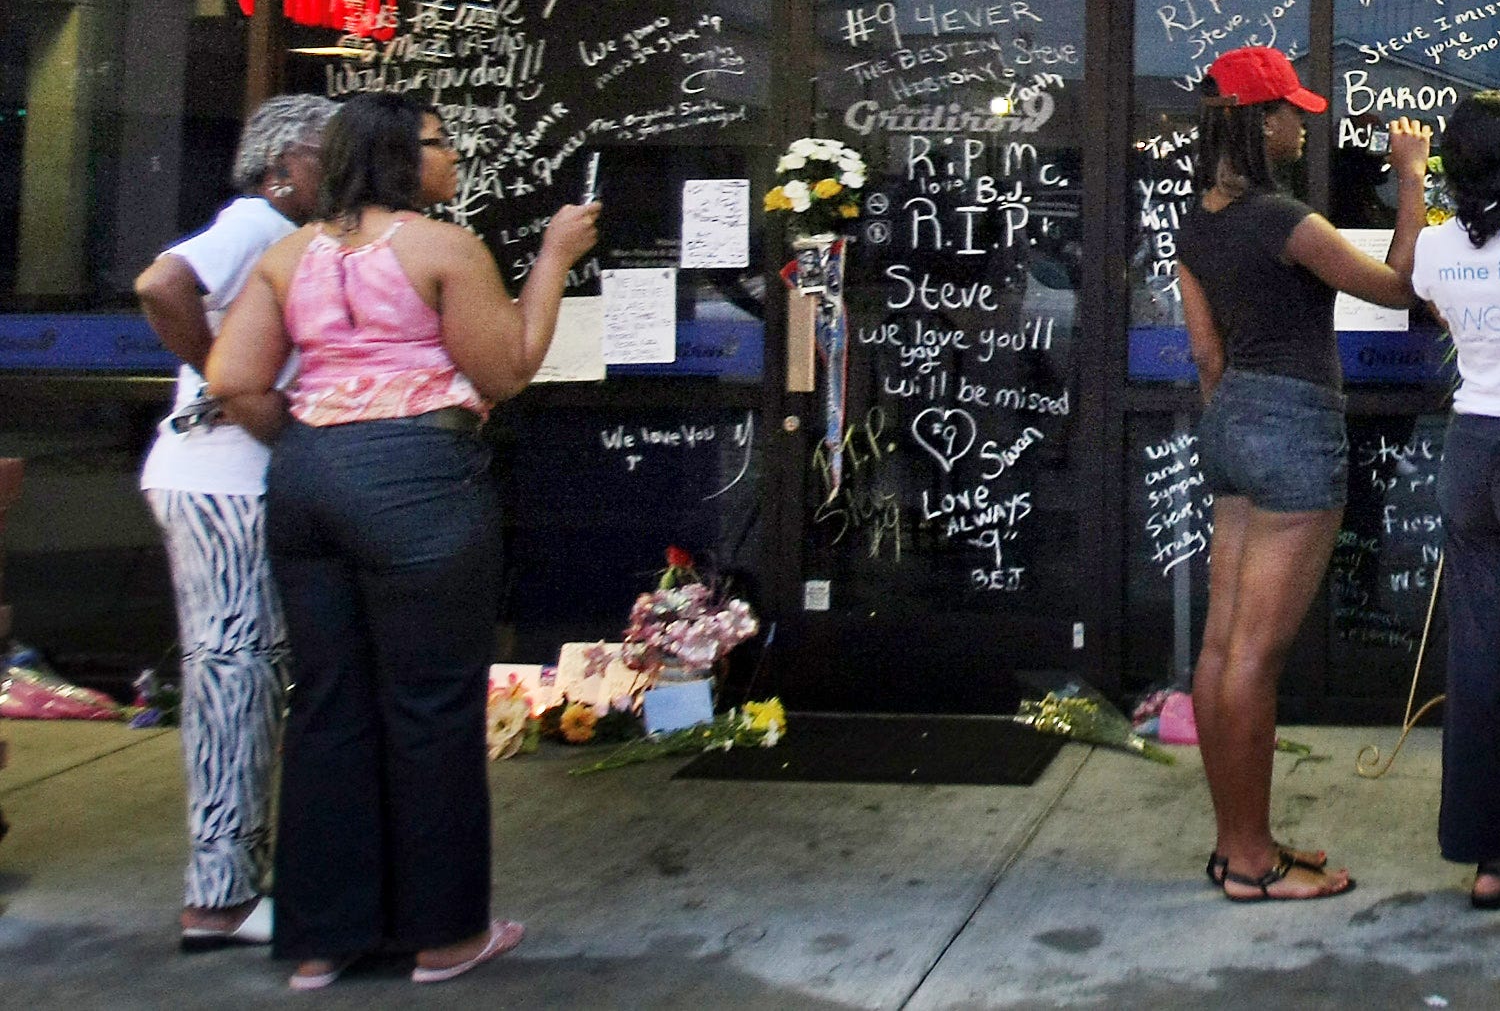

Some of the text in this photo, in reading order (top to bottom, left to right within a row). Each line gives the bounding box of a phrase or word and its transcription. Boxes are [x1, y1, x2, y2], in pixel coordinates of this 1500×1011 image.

[839, 0, 1043, 47] #9 4EVER
[886, 265, 998, 311] Steve
[1438, 262, 1489, 281] mine
[911, 320, 971, 350] love
[957, 377, 990, 406] be
[994, 388, 1070, 416] missed
